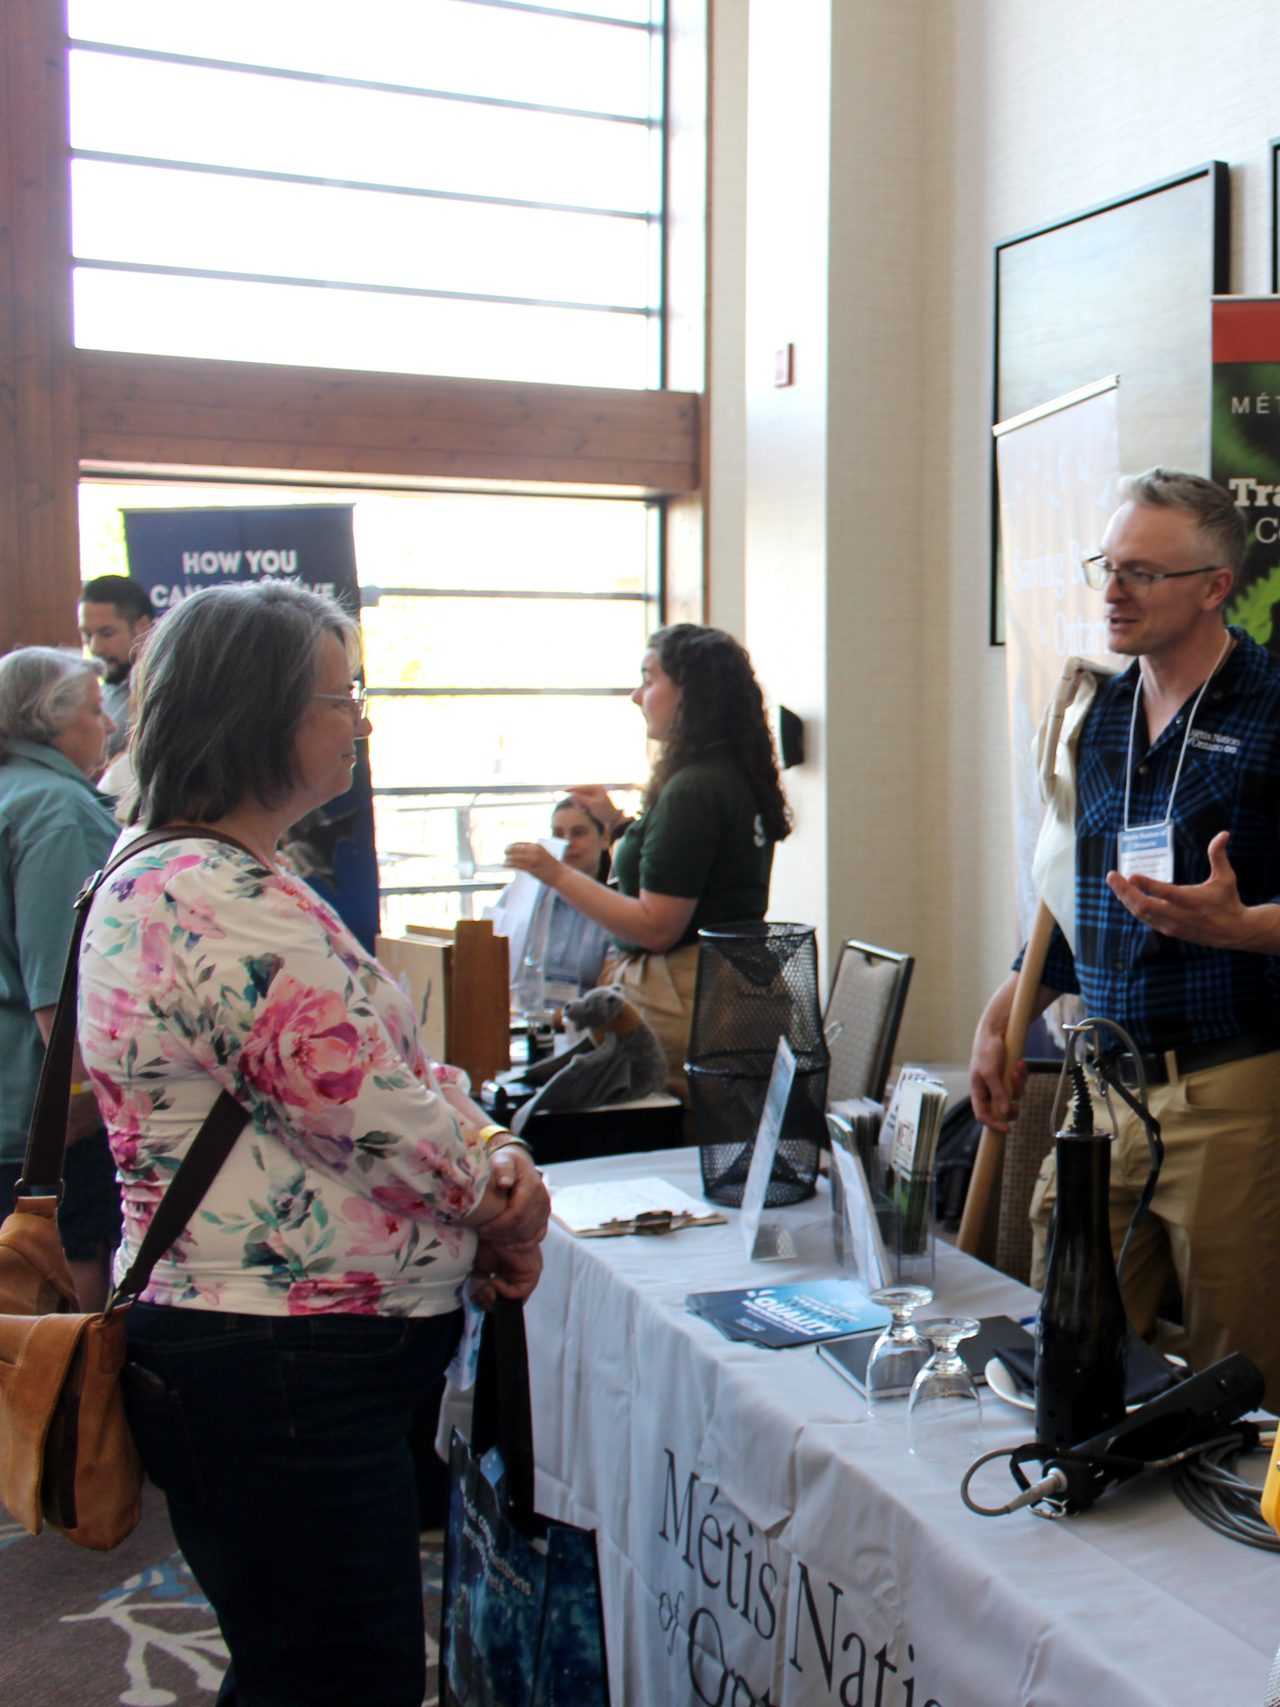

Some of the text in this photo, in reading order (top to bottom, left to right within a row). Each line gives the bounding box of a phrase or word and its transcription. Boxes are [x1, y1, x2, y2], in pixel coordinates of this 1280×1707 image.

[182, 549, 296, 576] HOW YOU
[753, 1296, 843, 1334] QUALITY
[658, 1447, 779, 1641] Métis
[789, 1561, 946, 1707] Nati
[658, 1590, 685, 1656] of
